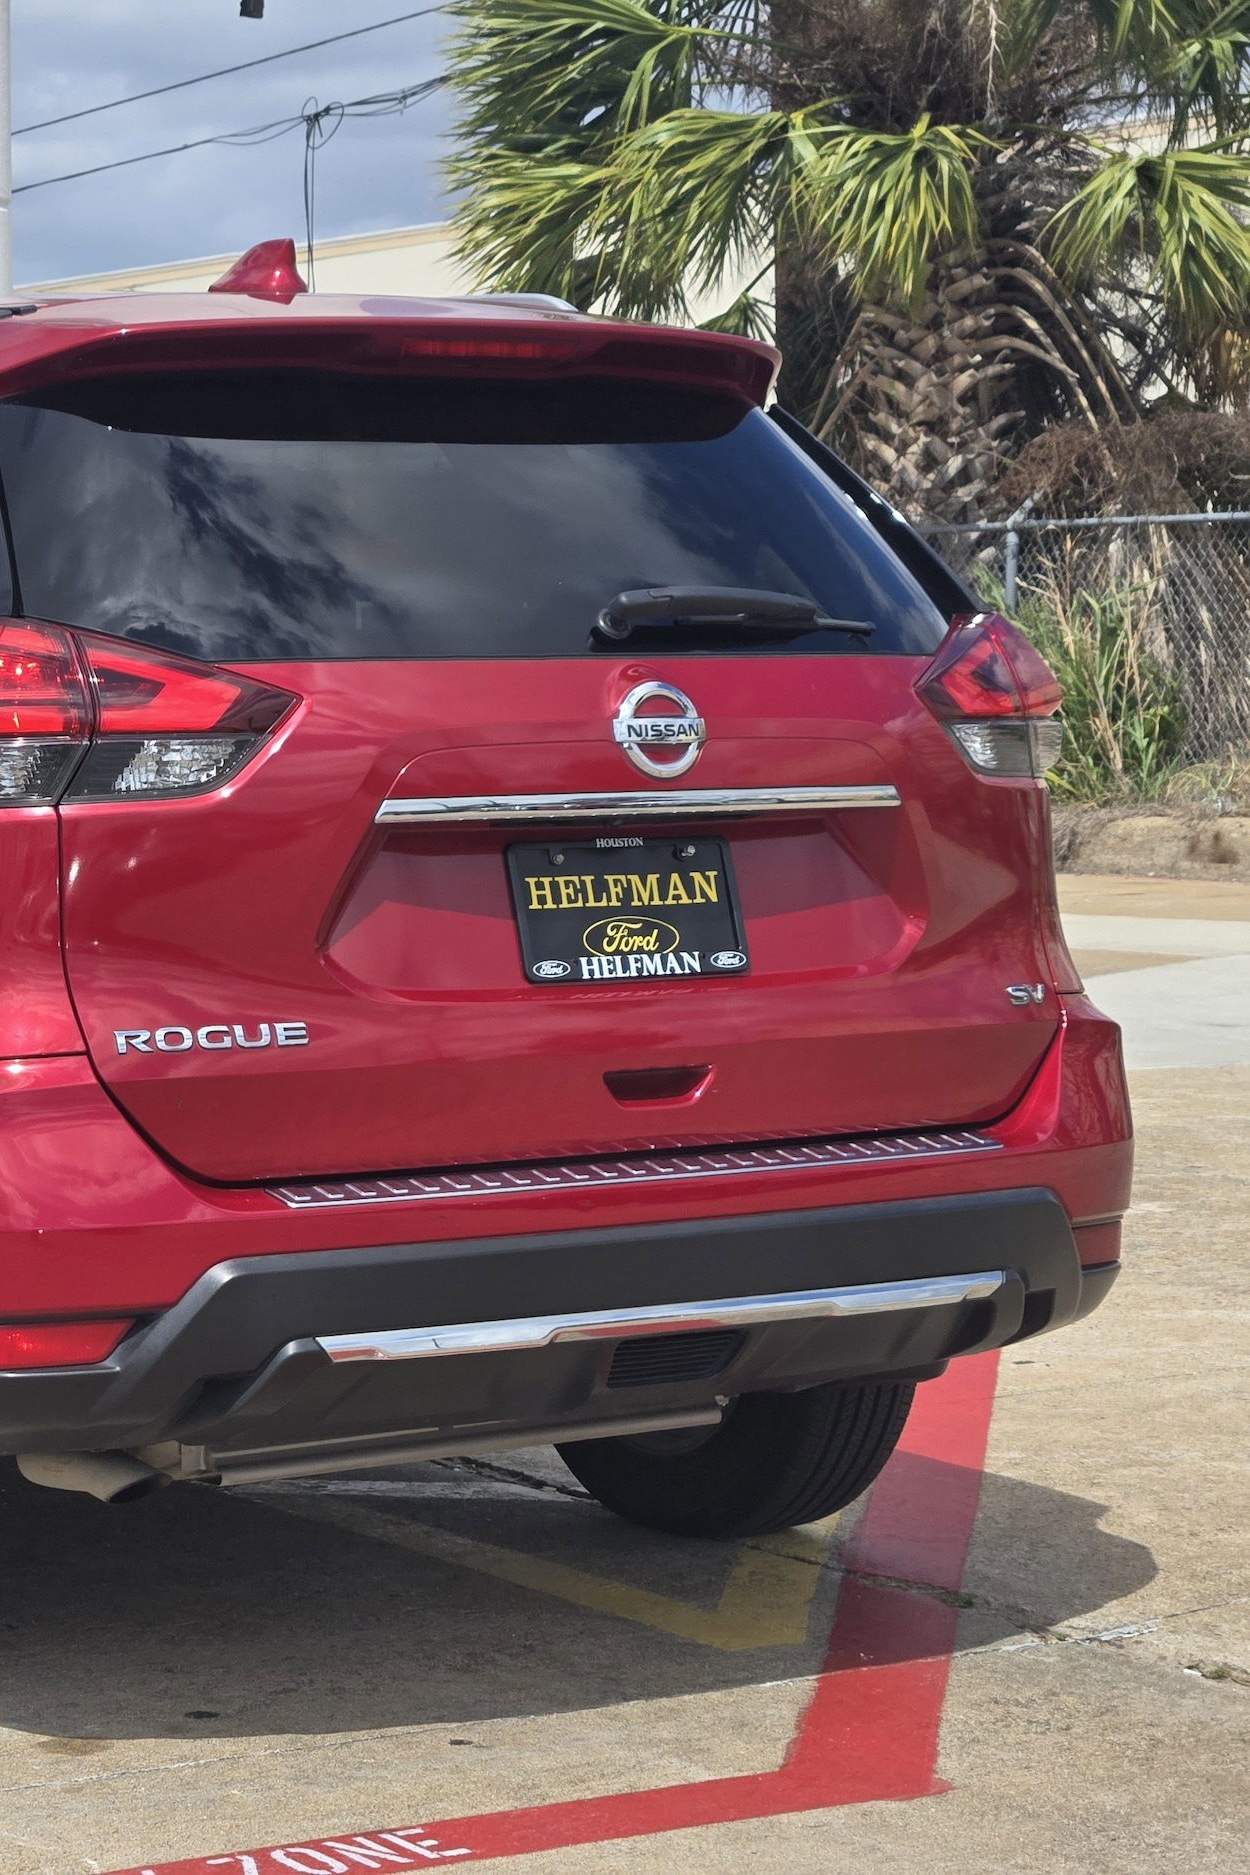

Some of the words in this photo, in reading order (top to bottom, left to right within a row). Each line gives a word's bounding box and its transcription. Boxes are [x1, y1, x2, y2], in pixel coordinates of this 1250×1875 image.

[626, 723, 700, 738] NISSAN
[595, 836, 644, 848] HOUSTON
[524, 870, 719, 910] HELFMAN
[602, 921, 660, 953] Ford
[578, 951, 701, 980] HELFMAN
[1005, 982, 1044, 1006] SV
[113, 1021, 310, 1055] ROGUE
